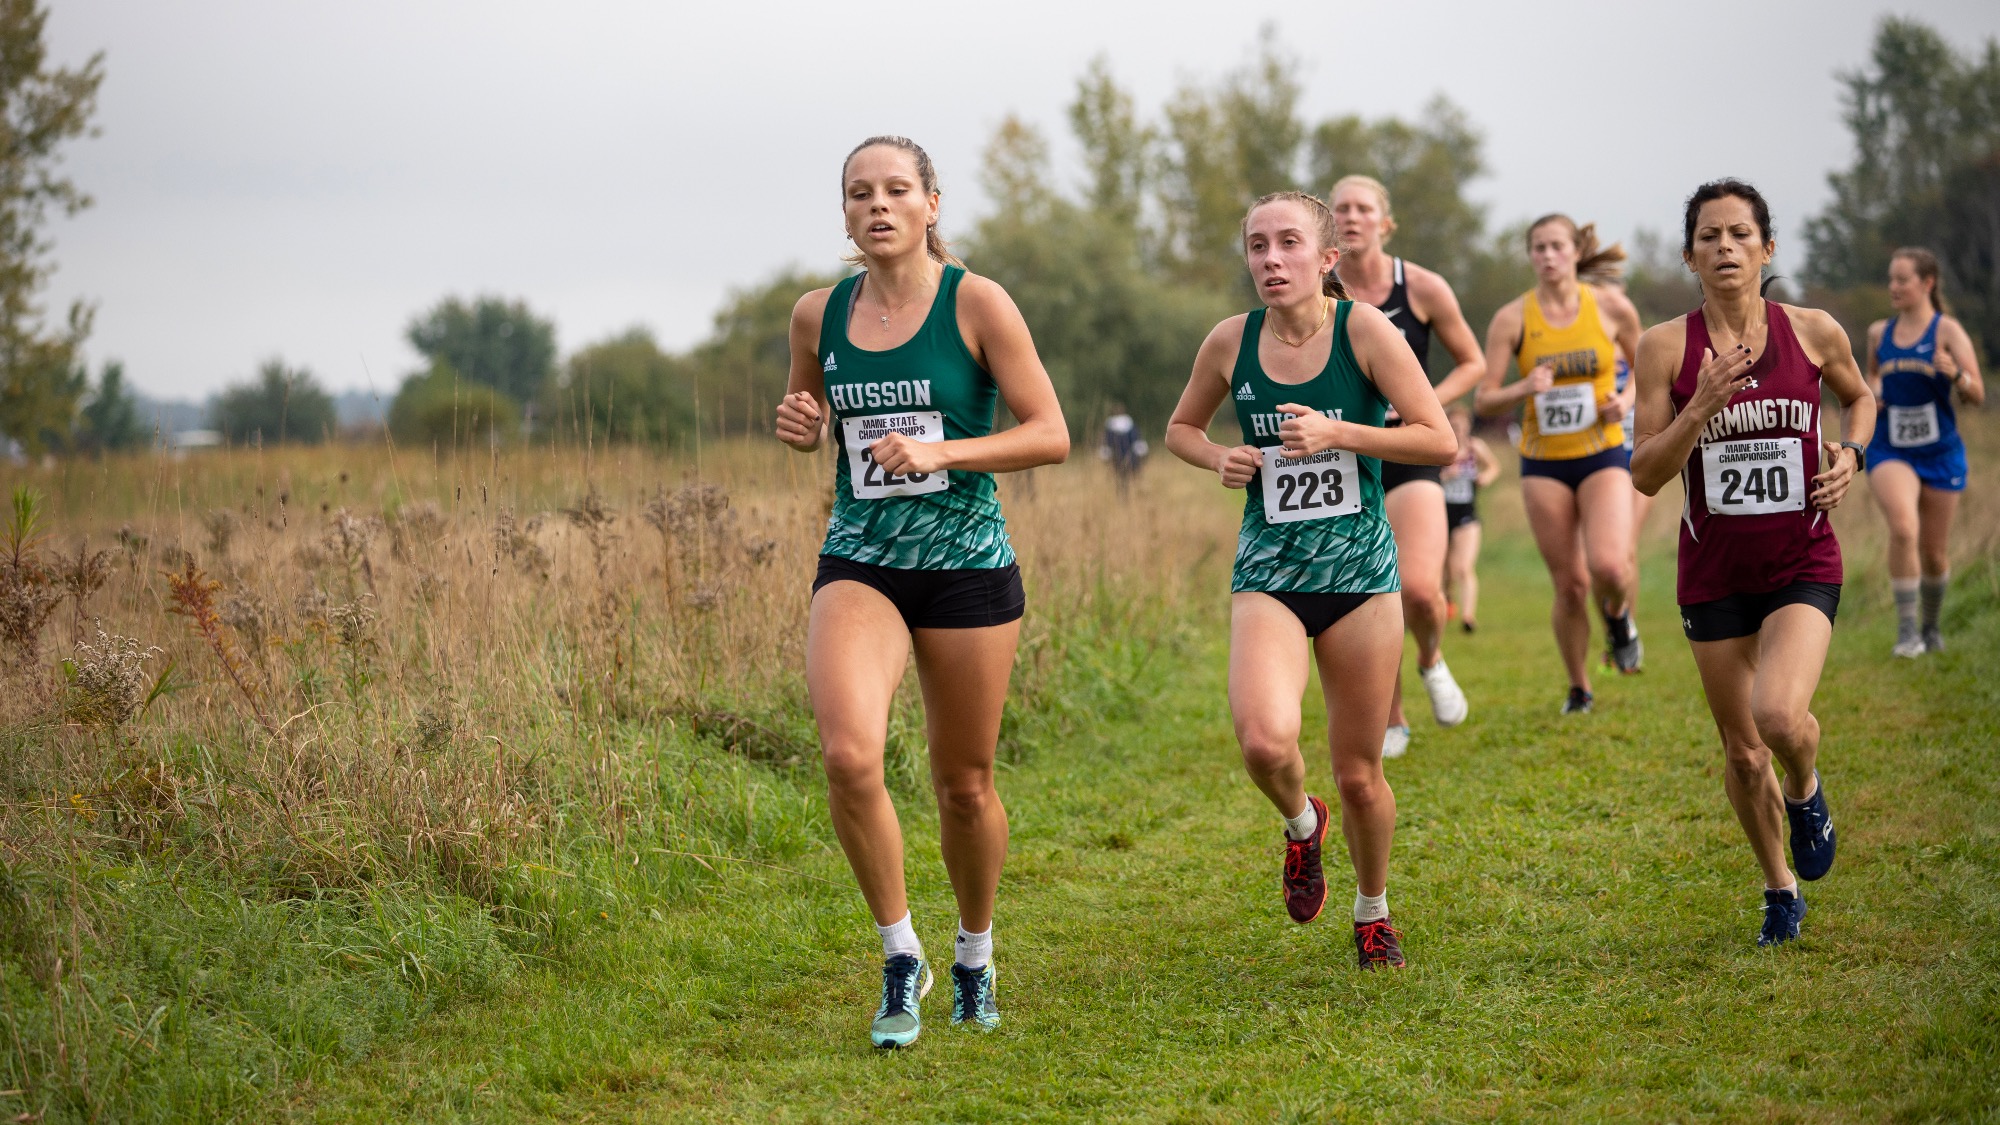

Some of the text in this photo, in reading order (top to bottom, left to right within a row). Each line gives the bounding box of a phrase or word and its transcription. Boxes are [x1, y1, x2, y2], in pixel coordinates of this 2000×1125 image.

[830, 379, 931, 411] HUSSON
[1236, 393, 1256, 401] adidas
[862, 415, 918, 430] MAINE STATE
[1545, 404, 1583, 428] 257
[1694, 398, 1813, 448] ARMINGTON
[1718, 449, 1787, 464] CHAMPIONSHIPS
[1725, 441, 1780, 454] MAINE STATE
[1274, 451, 1340, 469] CHAMPIONSHIPS
[1276, 468, 1344, 512] 223
[1720, 465, 1789, 505] 240
